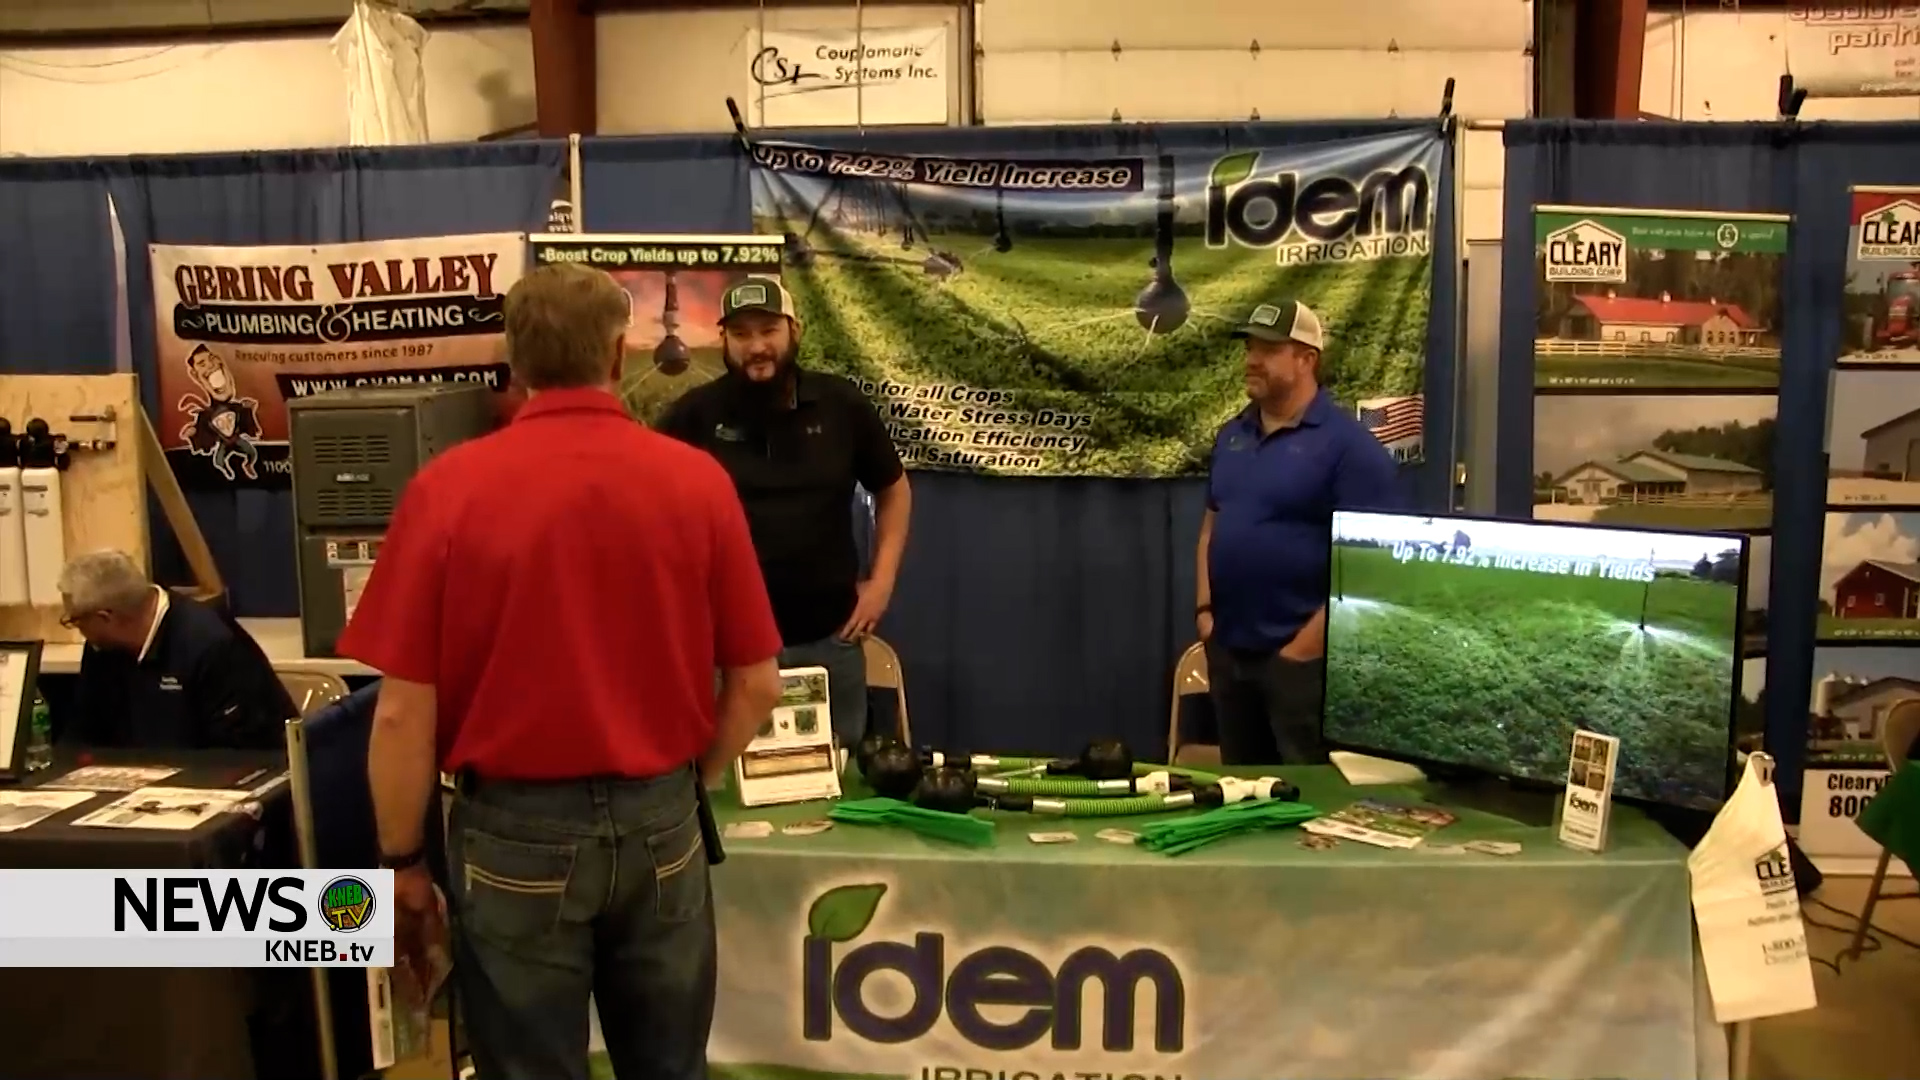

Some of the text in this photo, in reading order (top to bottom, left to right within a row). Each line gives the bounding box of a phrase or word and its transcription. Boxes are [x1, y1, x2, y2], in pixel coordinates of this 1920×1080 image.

[835, 64, 938, 82] Systems Inc.
[753, 146, 1131, 189] Up to 7.92% Yield Increase
[1206, 153, 1430, 249] idem
[591, 248, 626, 265] Crop
[629, 247, 674, 263] Yields
[677, 250, 699, 265] up
[702, 248, 718, 262] to
[722, 247, 779, 263] 7.92%
[1278, 236, 1429, 264] IRRIGATION
[1550, 241, 1622, 266] CLEARY
[175, 253, 498, 308] GERING VALLEY
[205, 304, 464, 343] PLUMBING & HEATING
[235, 345, 434, 364] Rescuing customers since 1987
[880, 380, 911, 397] for
[916, 384, 944, 400] all
[950, 386, 1013, 404] Crops
[890, 403, 952, 421] Water
[960, 407, 1033, 425] Stress
[1038, 411, 1093, 430] Days
[972, 430, 1086, 451] Efficiency
[927, 448, 1041, 468] Saturation
[1392, 540, 1414, 564] Up
[1419, 543, 1438, 562] To
[1494, 552, 1569, 575] Increase
[1598, 560, 1655, 582] Yields
[803, 884, 1185, 1053] idem
